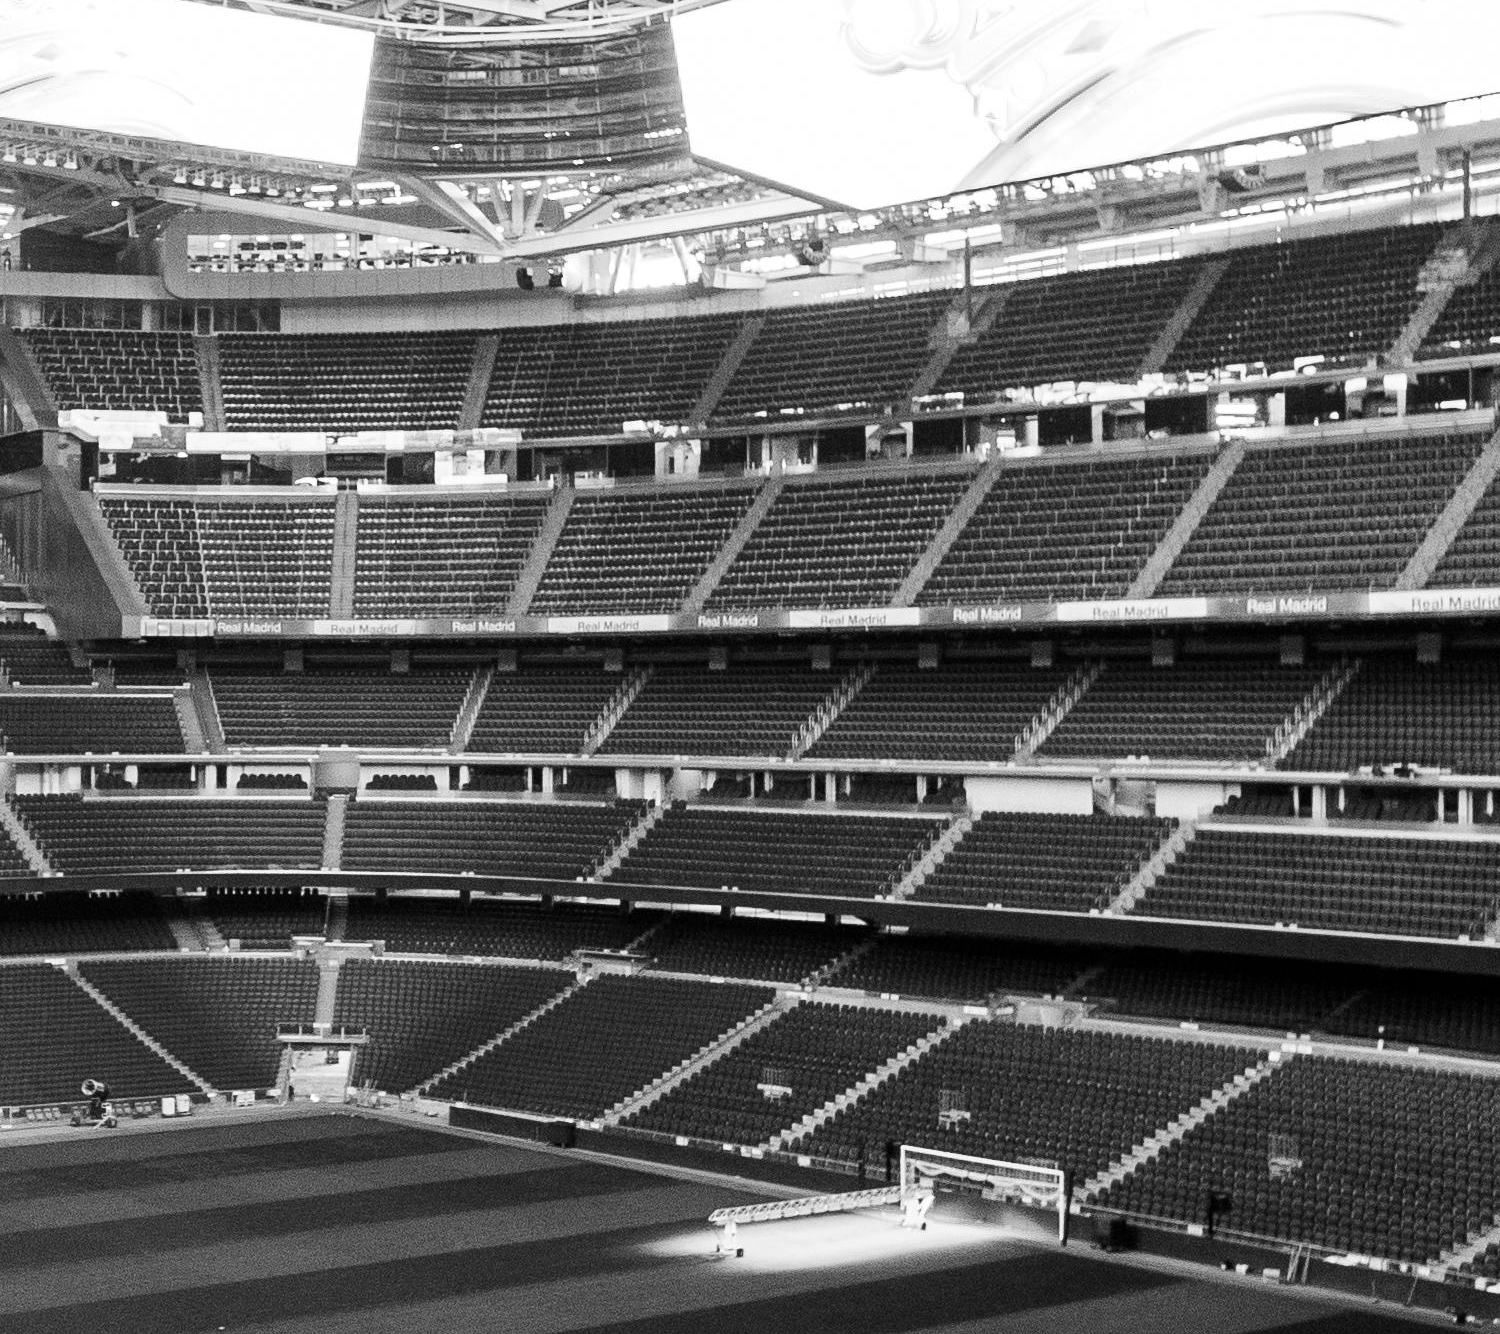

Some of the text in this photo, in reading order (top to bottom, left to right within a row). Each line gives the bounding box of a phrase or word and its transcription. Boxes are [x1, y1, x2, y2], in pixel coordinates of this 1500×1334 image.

[1247, 596, 1327, 614] Real Madrid
[1411, 595, 1500, 612] Real Madrid
[953, 606, 1021, 622] Real Madrid
[1092, 605, 1169, 620] Real Madrid
[452, 620, 515, 632] Real Madrid
[577, 619, 639, 632] Real Madrid
[698, 614, 758, 627] Real Madrid
[820, 613, 887, 626] Real Madrid
[217, 621, 282, 633] Real Madrid
[331, 623, 399, 634] Real Madrid
